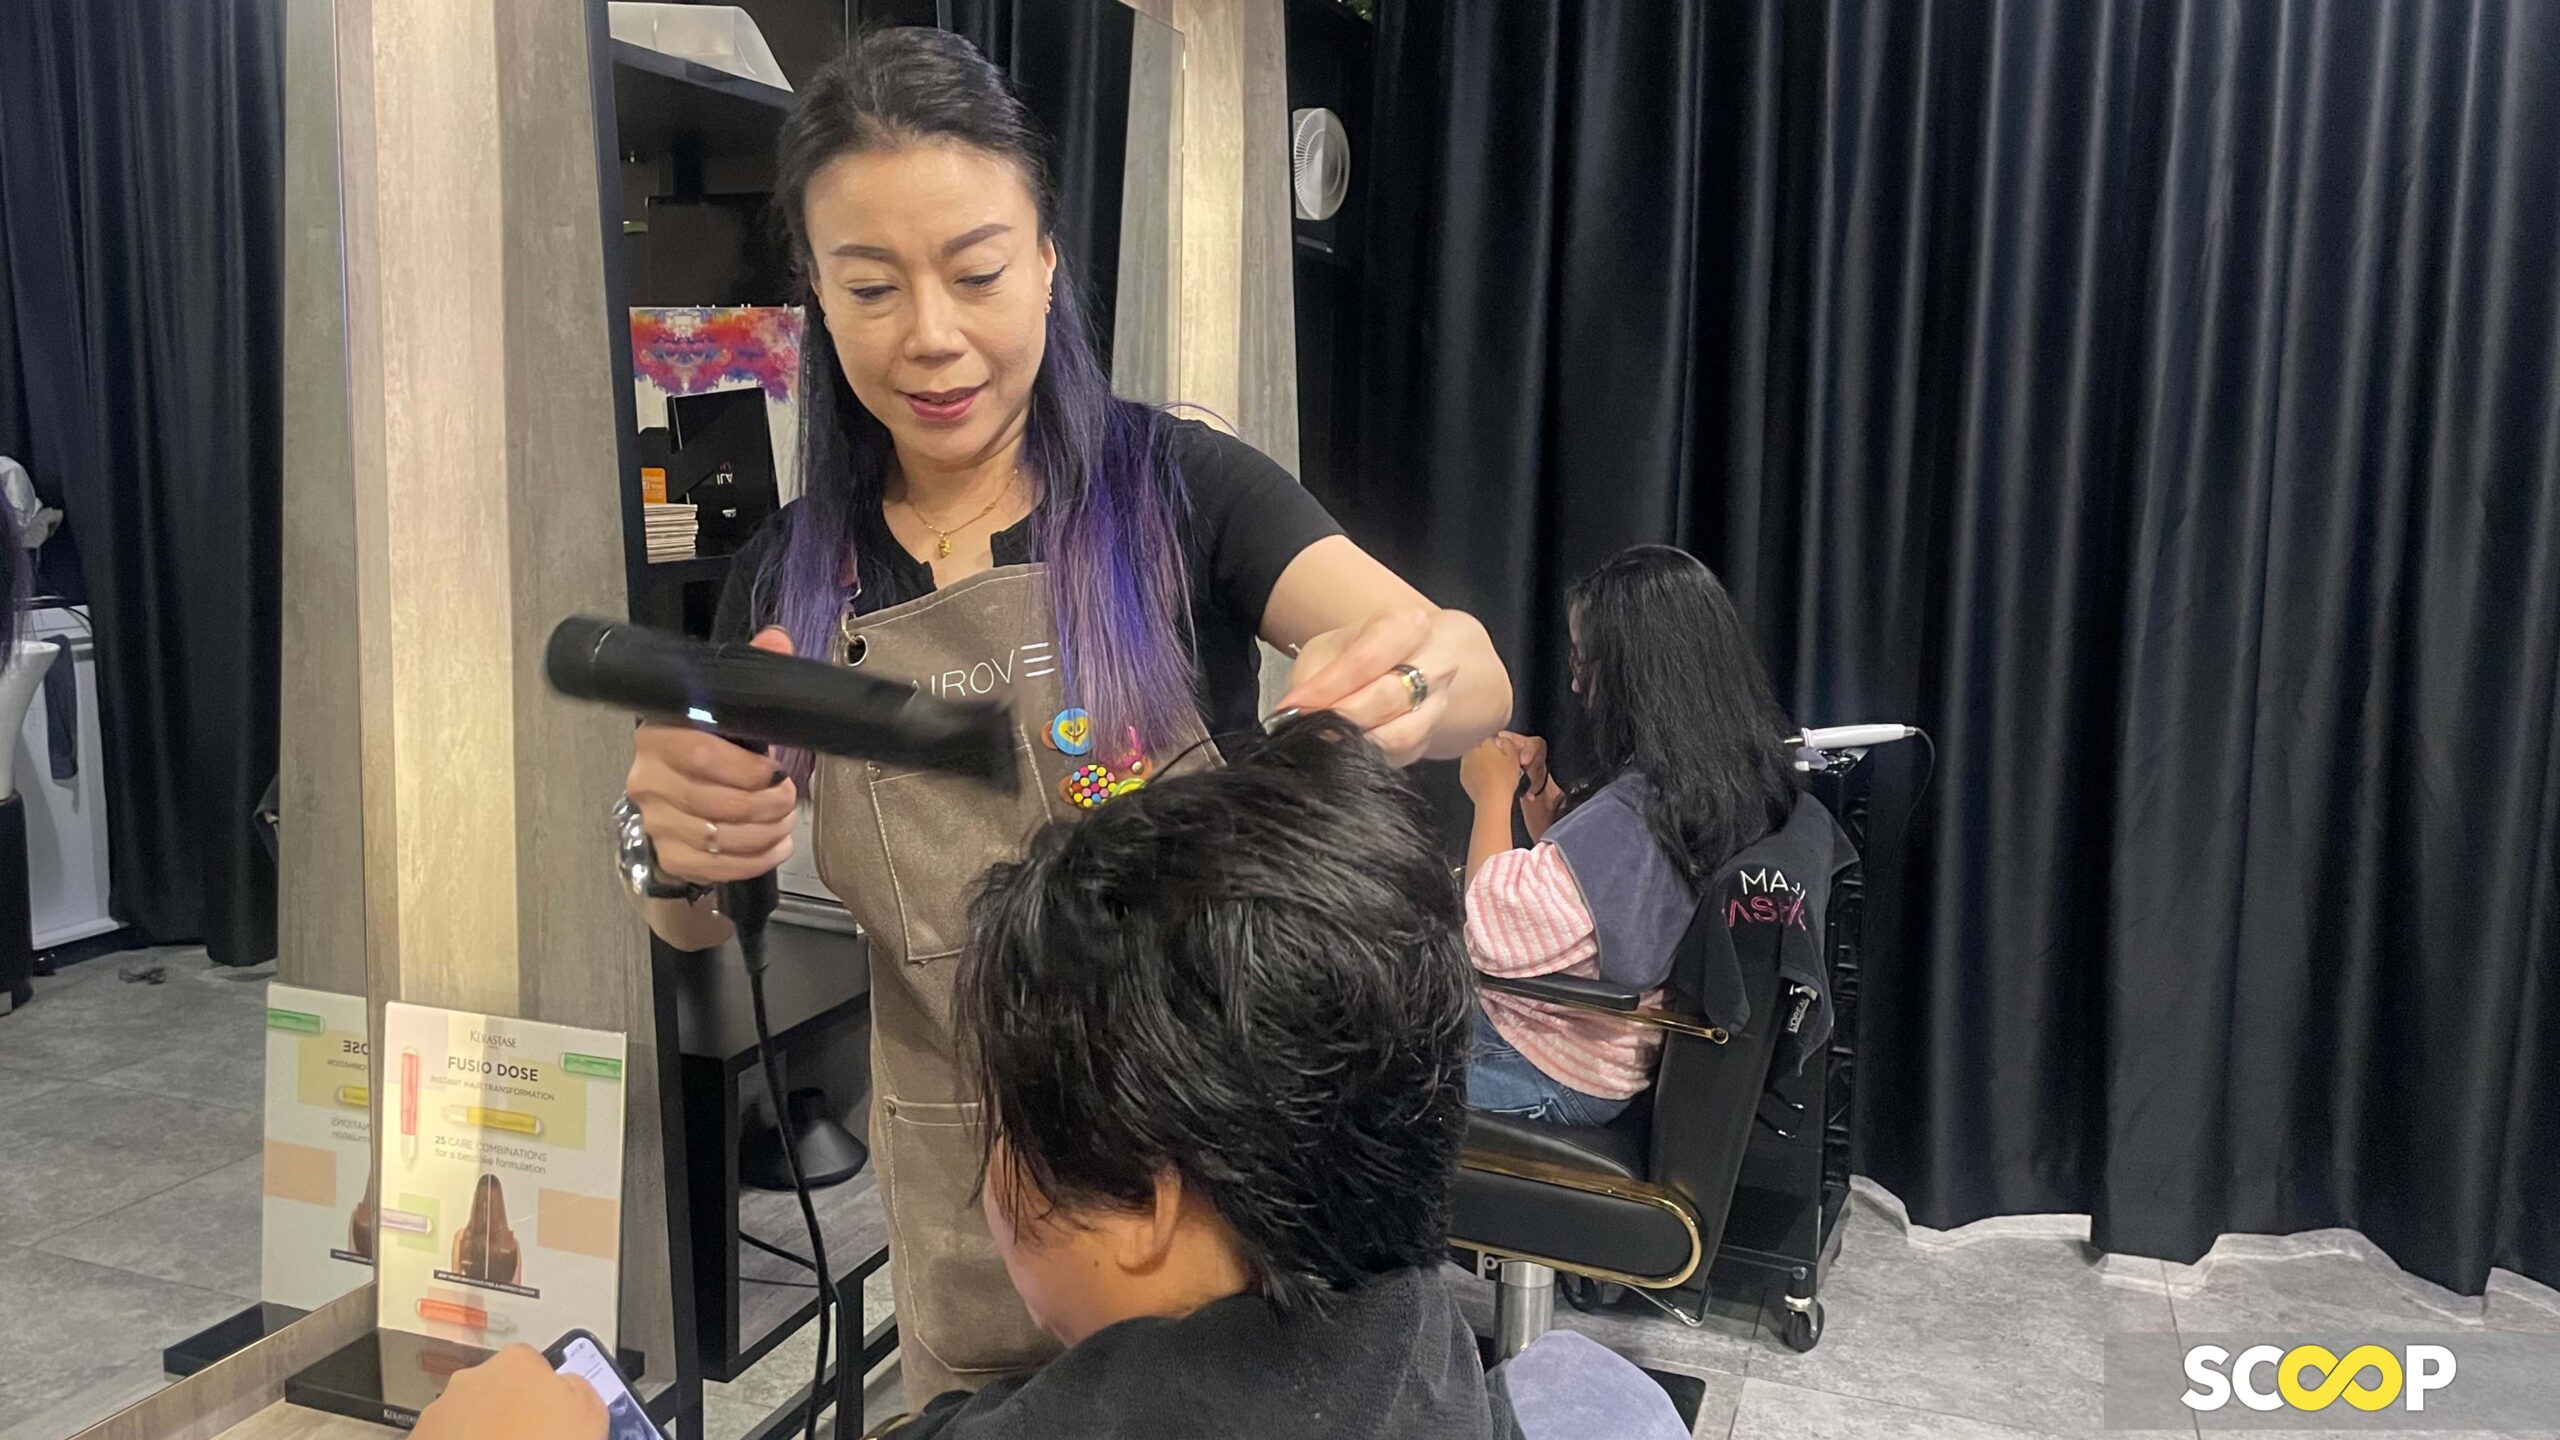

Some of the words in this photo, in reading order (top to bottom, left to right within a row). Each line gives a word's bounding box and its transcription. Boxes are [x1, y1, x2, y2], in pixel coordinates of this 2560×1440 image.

[447, 1056, 492, 1074] FUSIO
[497, 1063, 539, 1082] DOSE
[484, 1083, 555, 1101] TRANSFORMATION
[434, 1135, 446, 1145] 25
[476, 1142, 548, 1161] COMBINATIONS
[495, 1157, 547, 1174] formulation
